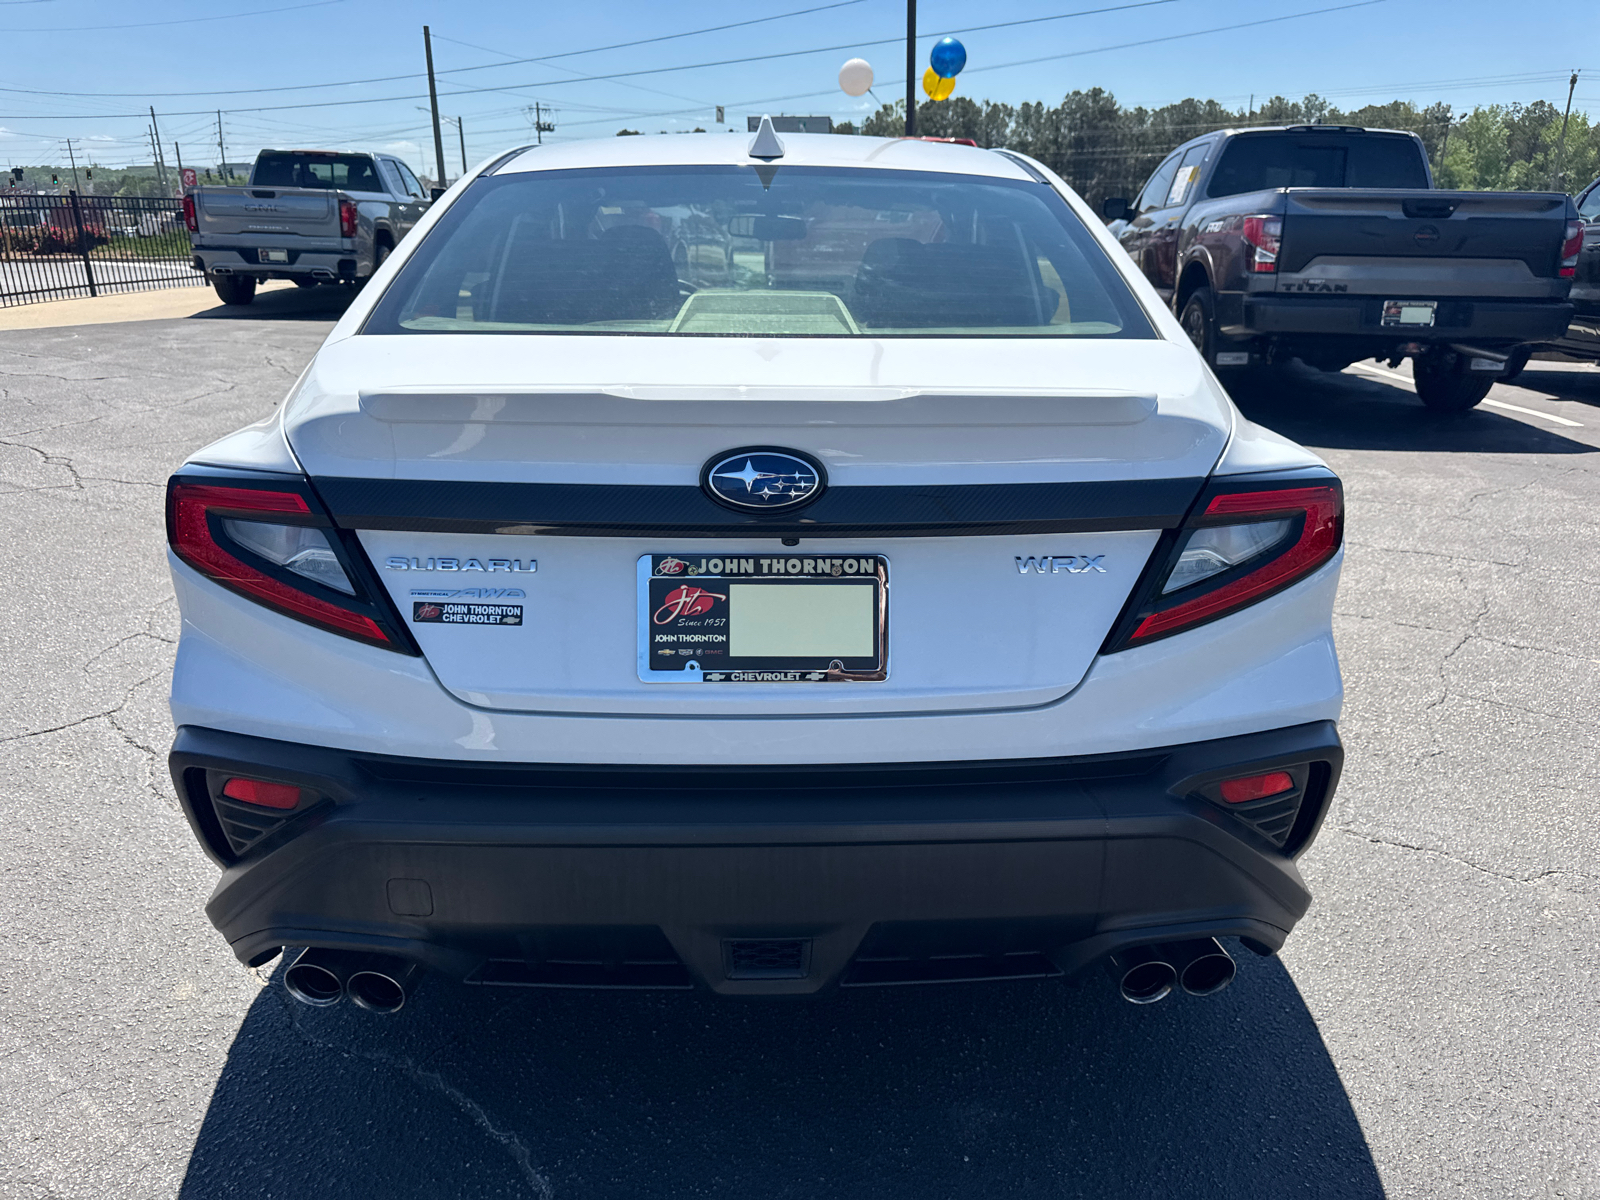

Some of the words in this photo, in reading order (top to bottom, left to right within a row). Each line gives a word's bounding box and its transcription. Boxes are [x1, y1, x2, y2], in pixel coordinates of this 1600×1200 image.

[244, 204, 288, 213] GMC
[1282, 283, 1348, 292] TITAN
[385, 557, 538, 573] SUBARU
[698, 558, 754, 574] JOHN
[1014, 554, 1107, 574] WRX
[448, 587, 526, 599] AWD
[443, 604, 468, 614] JOHN
[469, 605, 521, 616] THORNTON
[442, 613, 502, 624] CHEVROLET
[677, 618, 702, 627] Since
[704, 618, 726, 627] 1957
[655, 634, 677, 643] JOHN
[678, 634, 726, 643] THORNTON
[731, 672, 801, 681] CHEVROLET
